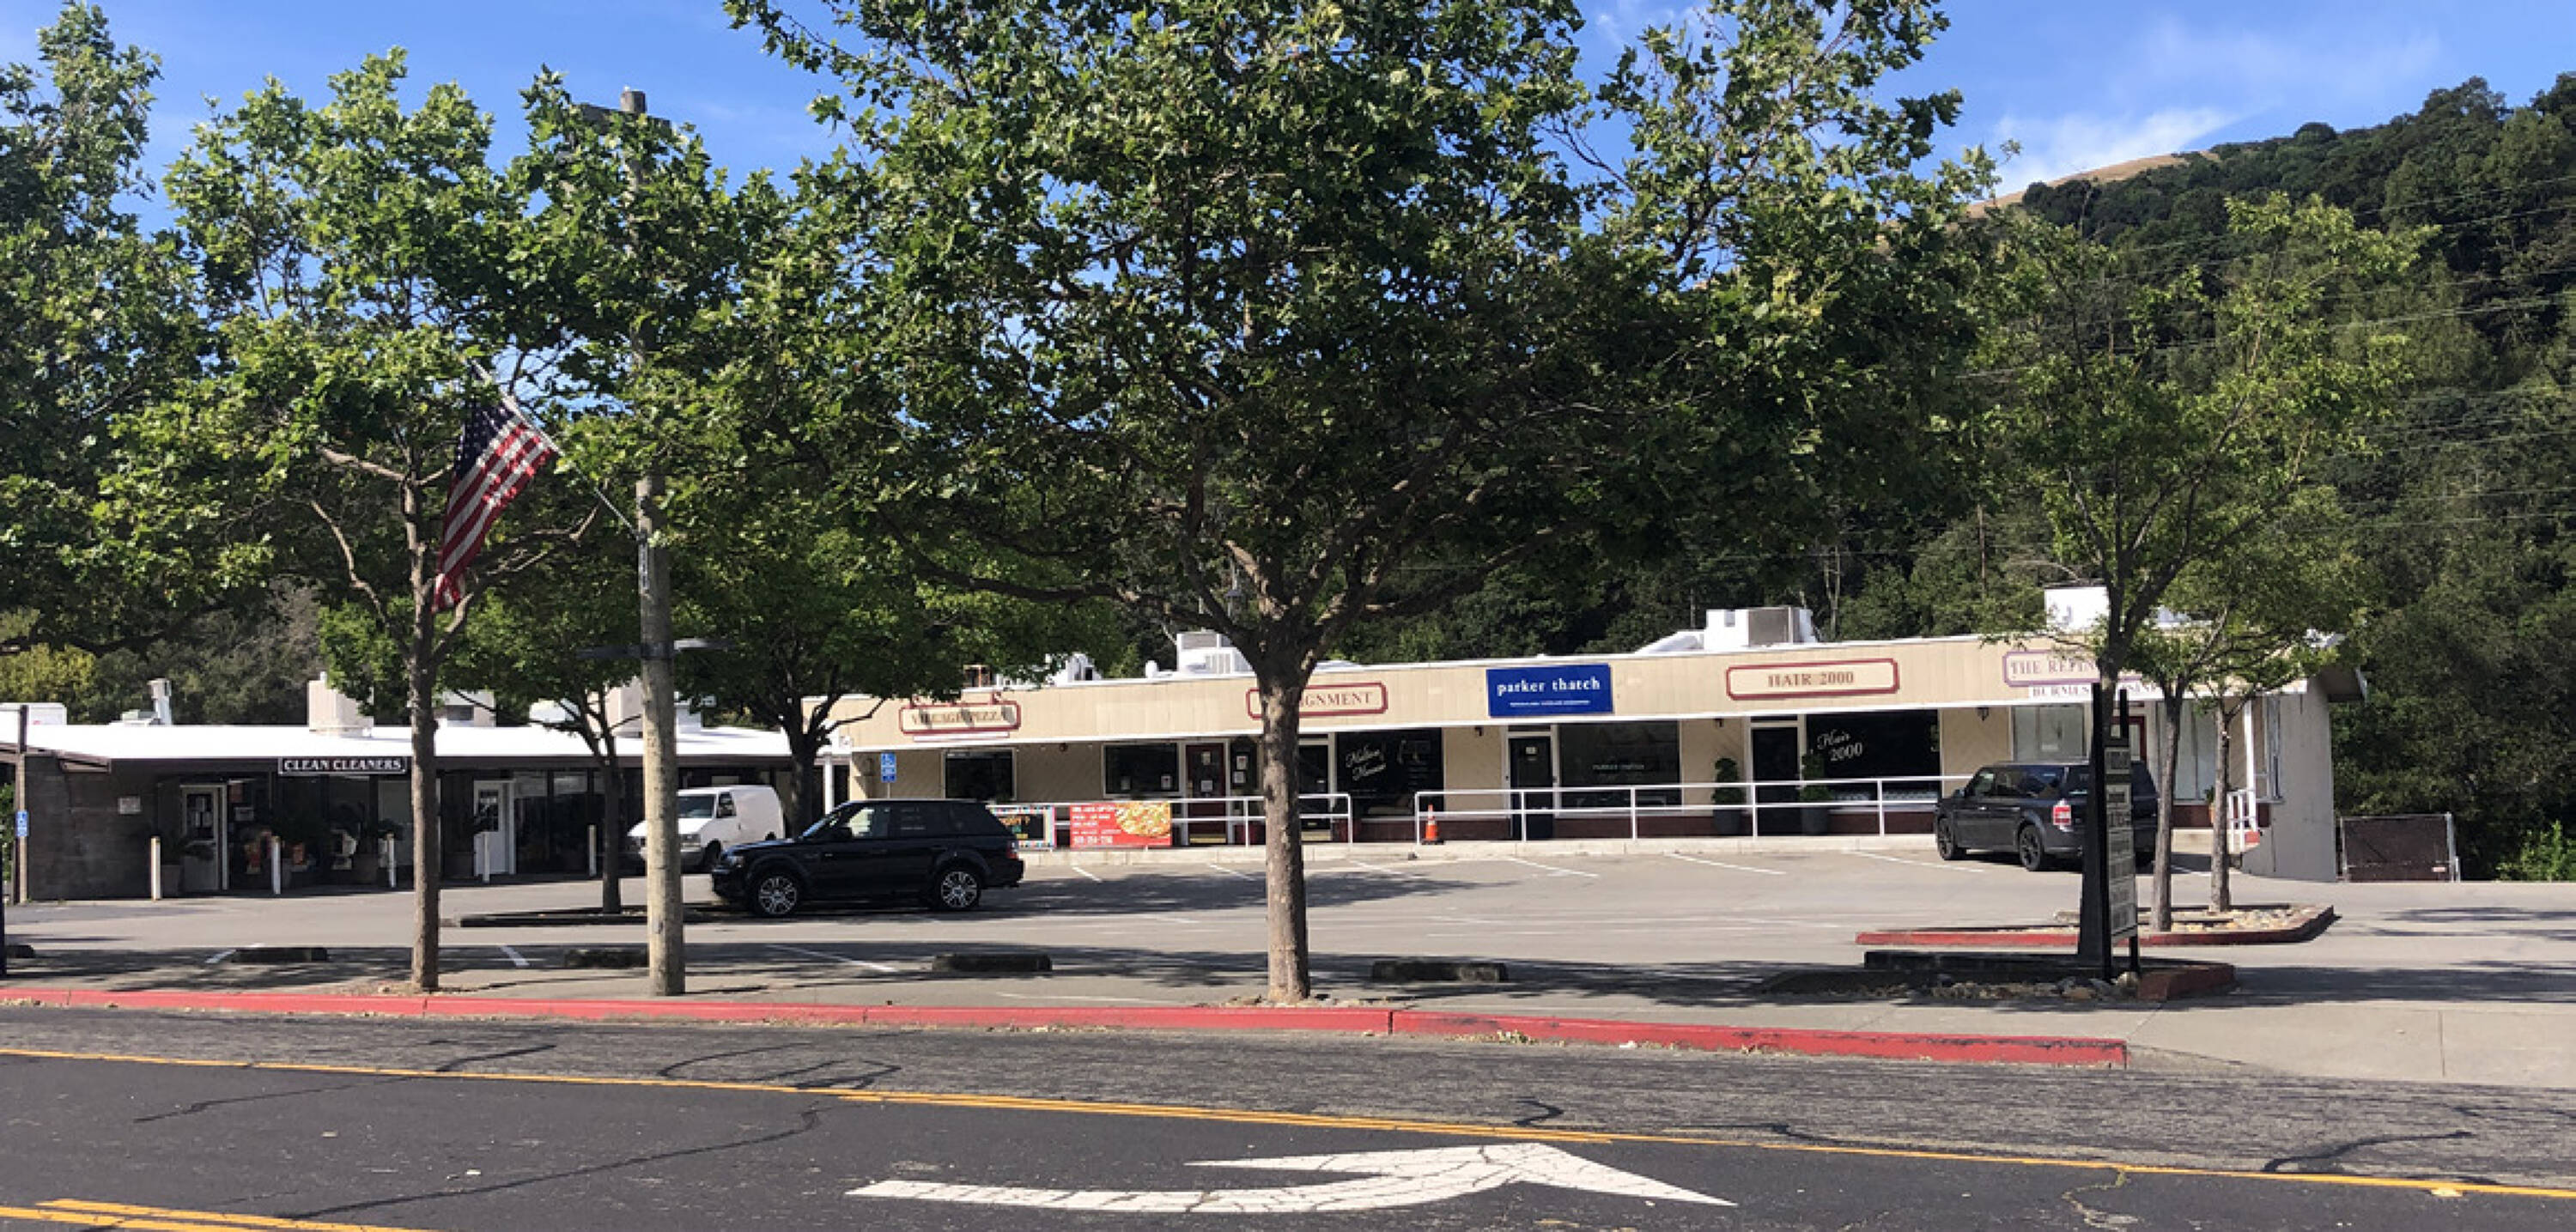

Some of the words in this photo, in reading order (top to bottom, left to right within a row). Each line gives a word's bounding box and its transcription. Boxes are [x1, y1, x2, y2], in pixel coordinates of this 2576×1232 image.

[2011, 660, 2041, 675] THE
[1497, 679, 1546, 697] parker
[1552, 676, 1601, 692] thatch
[1767, 673, 1812, 688] HAIR
[1819, 671, 1855, 686] 2000
[1300, 692, 1372, 707] IGNMENT
[1817, 729, 1851, 750] Hair
[1830, 743, 1862, 762] 2000
[283, 760, 330, 770] CLEAN
[332, 760, 401, 770] CLEANERS
